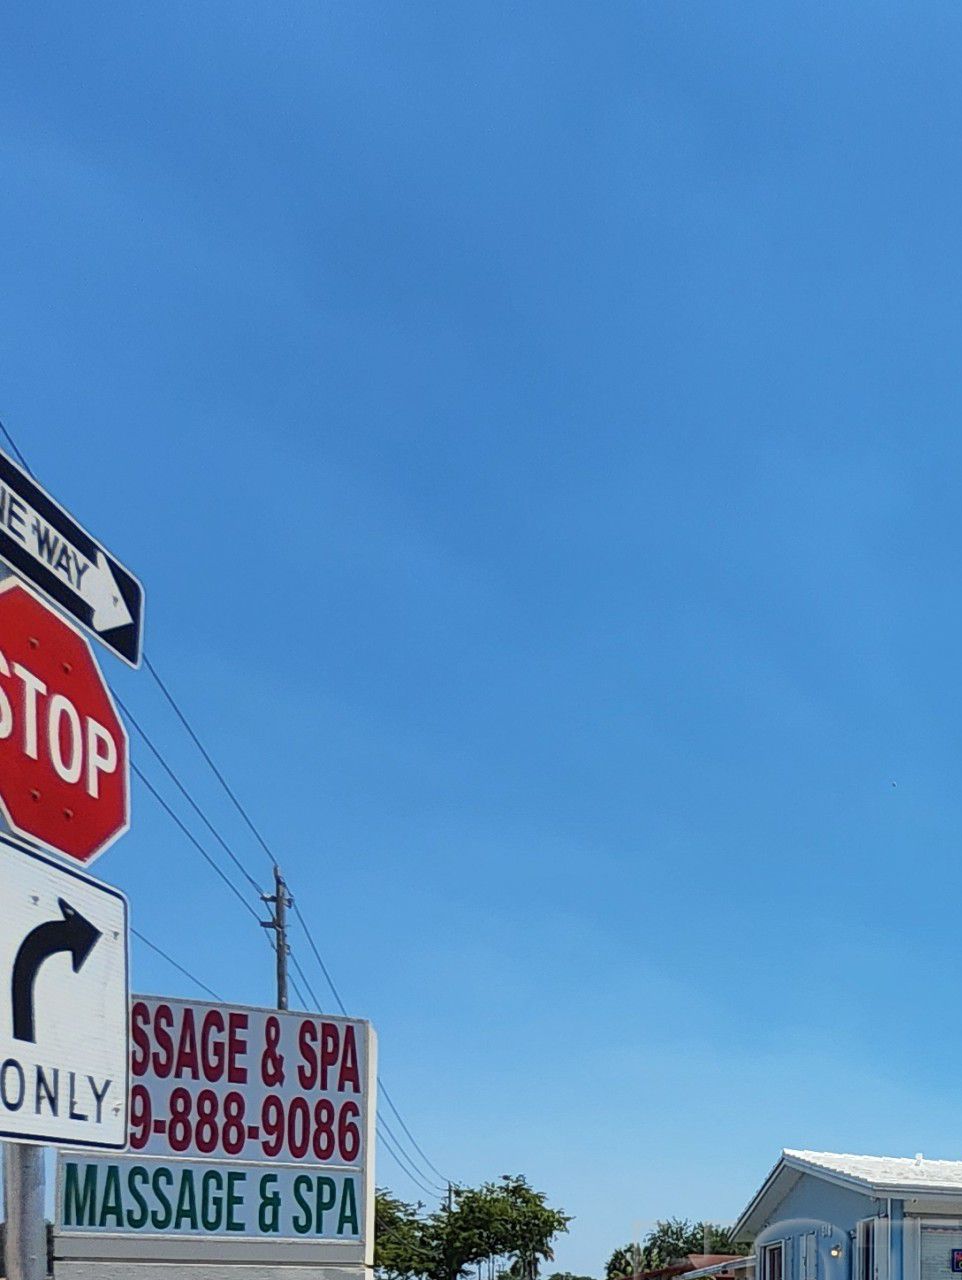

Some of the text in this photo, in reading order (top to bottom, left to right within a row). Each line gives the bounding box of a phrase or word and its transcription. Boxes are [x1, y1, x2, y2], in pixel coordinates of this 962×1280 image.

[34, 516, 89, 591] WAY
[0, 1058, 113, 1124] ONLY
[261, 1016, 285, 1088] &
[297, 1020, 361, 1093] SPA
[129, 1084, 361, 1162] 9-888-9086
[64, 1162, 360, 1236] MASSAGE & SPA
